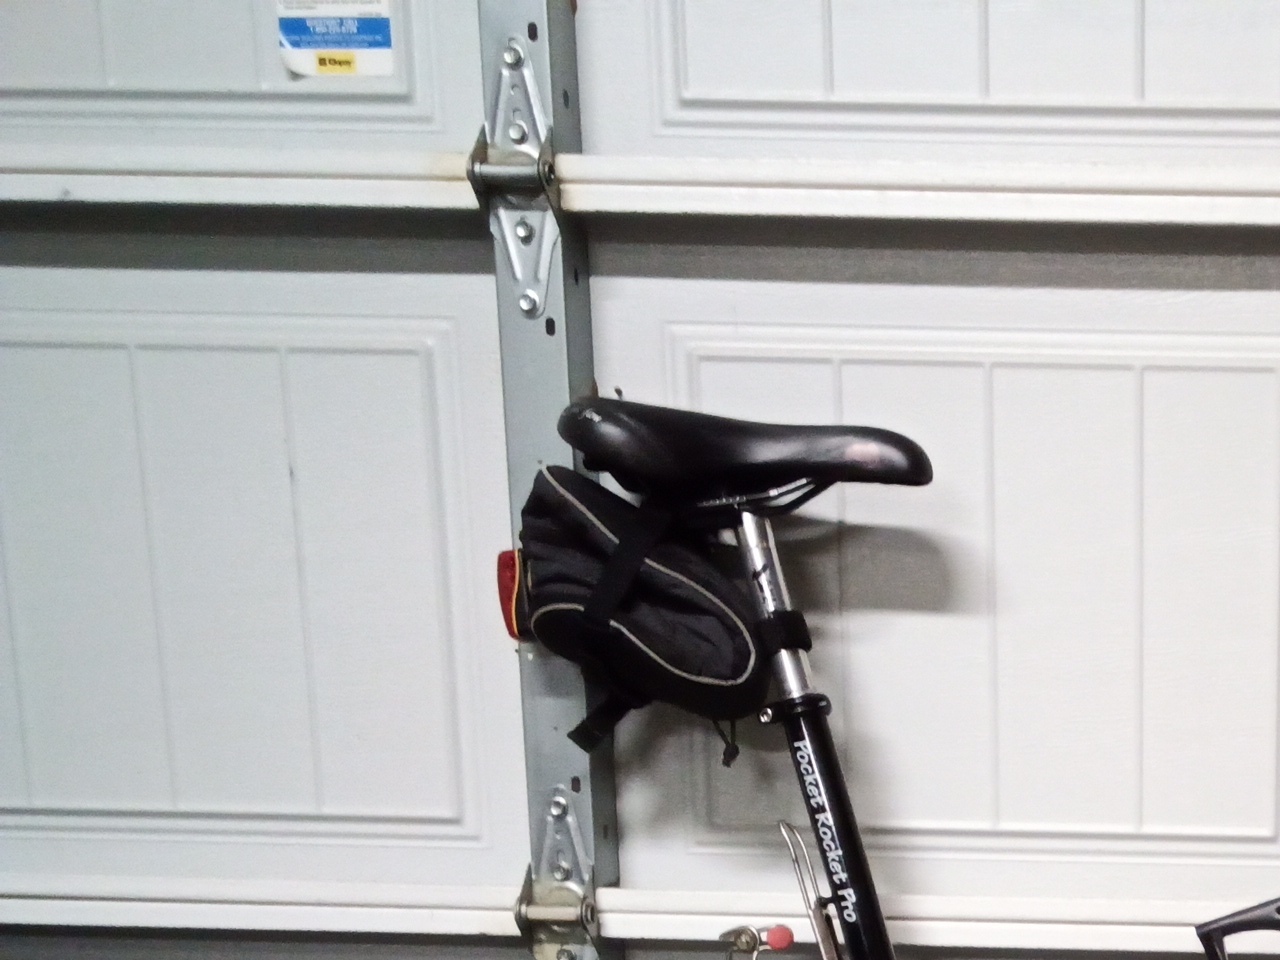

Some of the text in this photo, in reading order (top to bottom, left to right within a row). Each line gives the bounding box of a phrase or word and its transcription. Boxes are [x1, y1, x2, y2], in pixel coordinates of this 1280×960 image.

[793, 740, 857, 923] Pocket Rocket Pro
